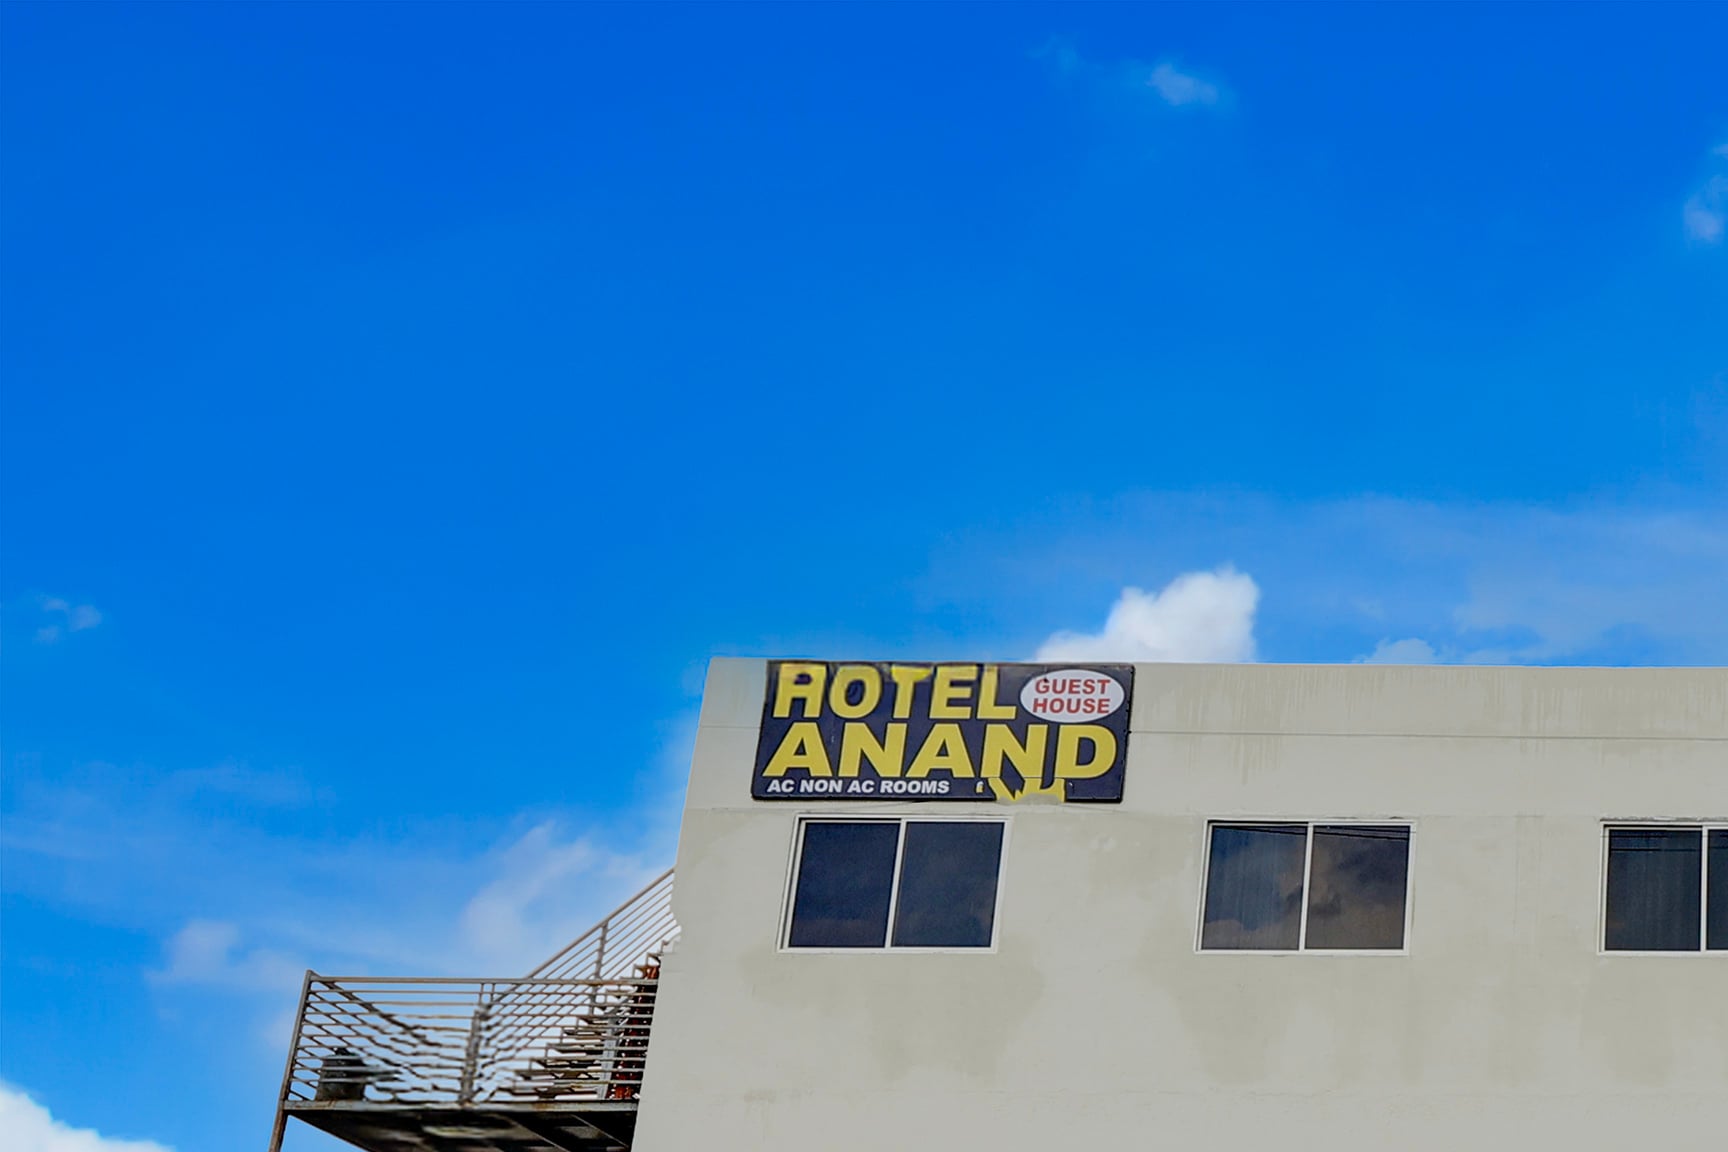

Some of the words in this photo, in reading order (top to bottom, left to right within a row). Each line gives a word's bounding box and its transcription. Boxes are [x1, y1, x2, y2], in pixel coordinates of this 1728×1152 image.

[1035, 678, 1111, 696] GUEST
[1032, 697, 1110, 715] HOUSE
[762, 722, 1117, 779] ANAND
[767, 780, 795, 793] AC
[800, 780, 843, 794] NON
[848, 781, 876, 794] AC
[880, 781, 950, 795] ROOMS
